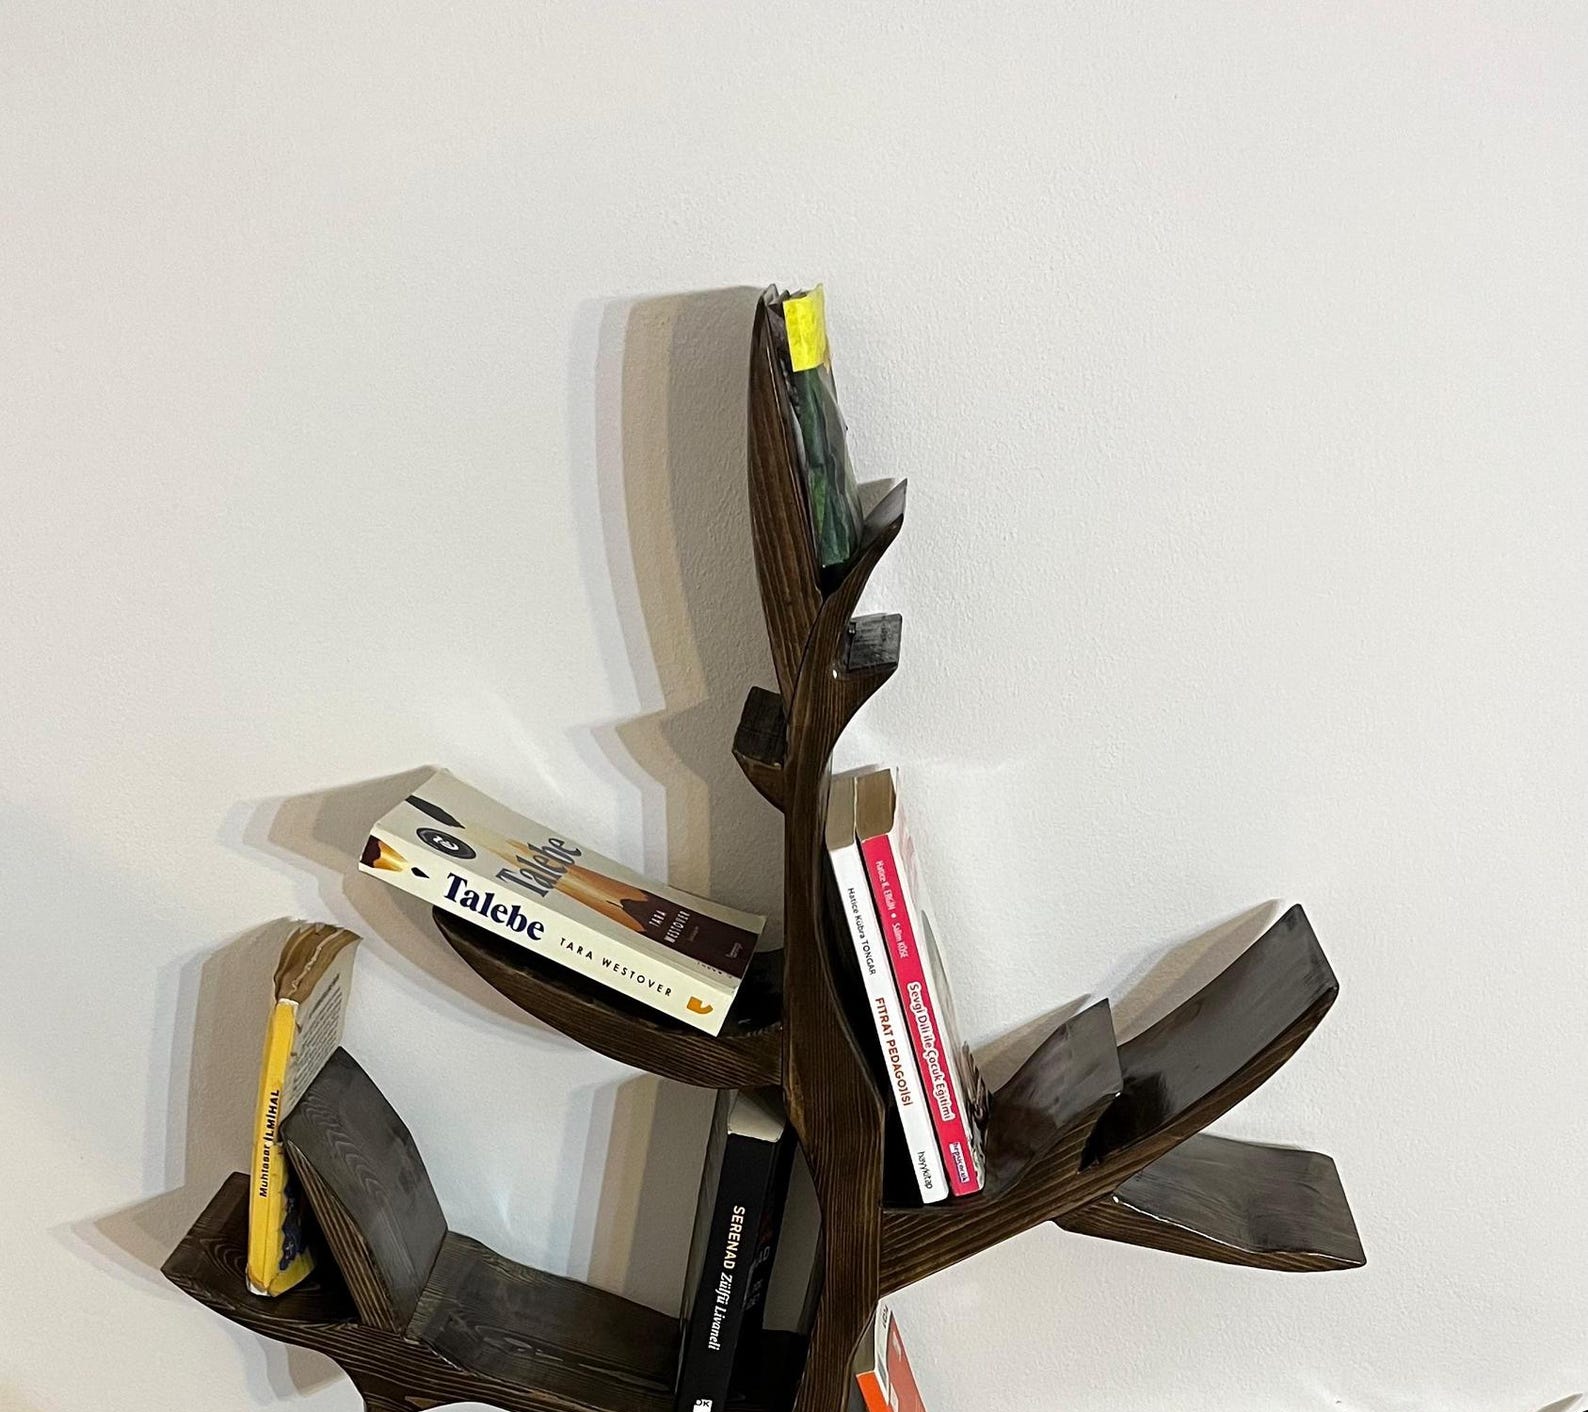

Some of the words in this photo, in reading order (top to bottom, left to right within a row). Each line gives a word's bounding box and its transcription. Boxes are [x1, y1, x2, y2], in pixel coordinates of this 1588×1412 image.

[495, 837, 582, 898] Talebe
[444, 872, 545, 941] Talebe
[649, 909, 667, 927] TARA
[664, 910, 690, 944] WESTOVER
[848, 887, 859, 914] Hatice
[855, 914, 865, 939] Kübra
[861, 940, 876, 976] TONGAR
[560, 936, 593, 961] TARA
[602, 957, 672, 997] WESTOVER
[875, 997, 894, 1037] FITRAT
[909, 983, 922, 1014] Sevgi
[918, 1014, 930, 1035] Dili
[924, 1034, 933, 1049] ile
[924, 1048, 943, 1082] Çocuk
[263, 1089, 280, 1142] İLMİHAL
[935, 1082, 952, 1120] Eğitimi
[259, 1144, 271, 1198] Muhtasar
[917, 1151, 933, 1189] hayykitap
[723, 1205, 746, 1270] SERENAD
[715, 1271, 733, 1306] Zülfü
[708, 1305, 727, 1350] Livaneli
